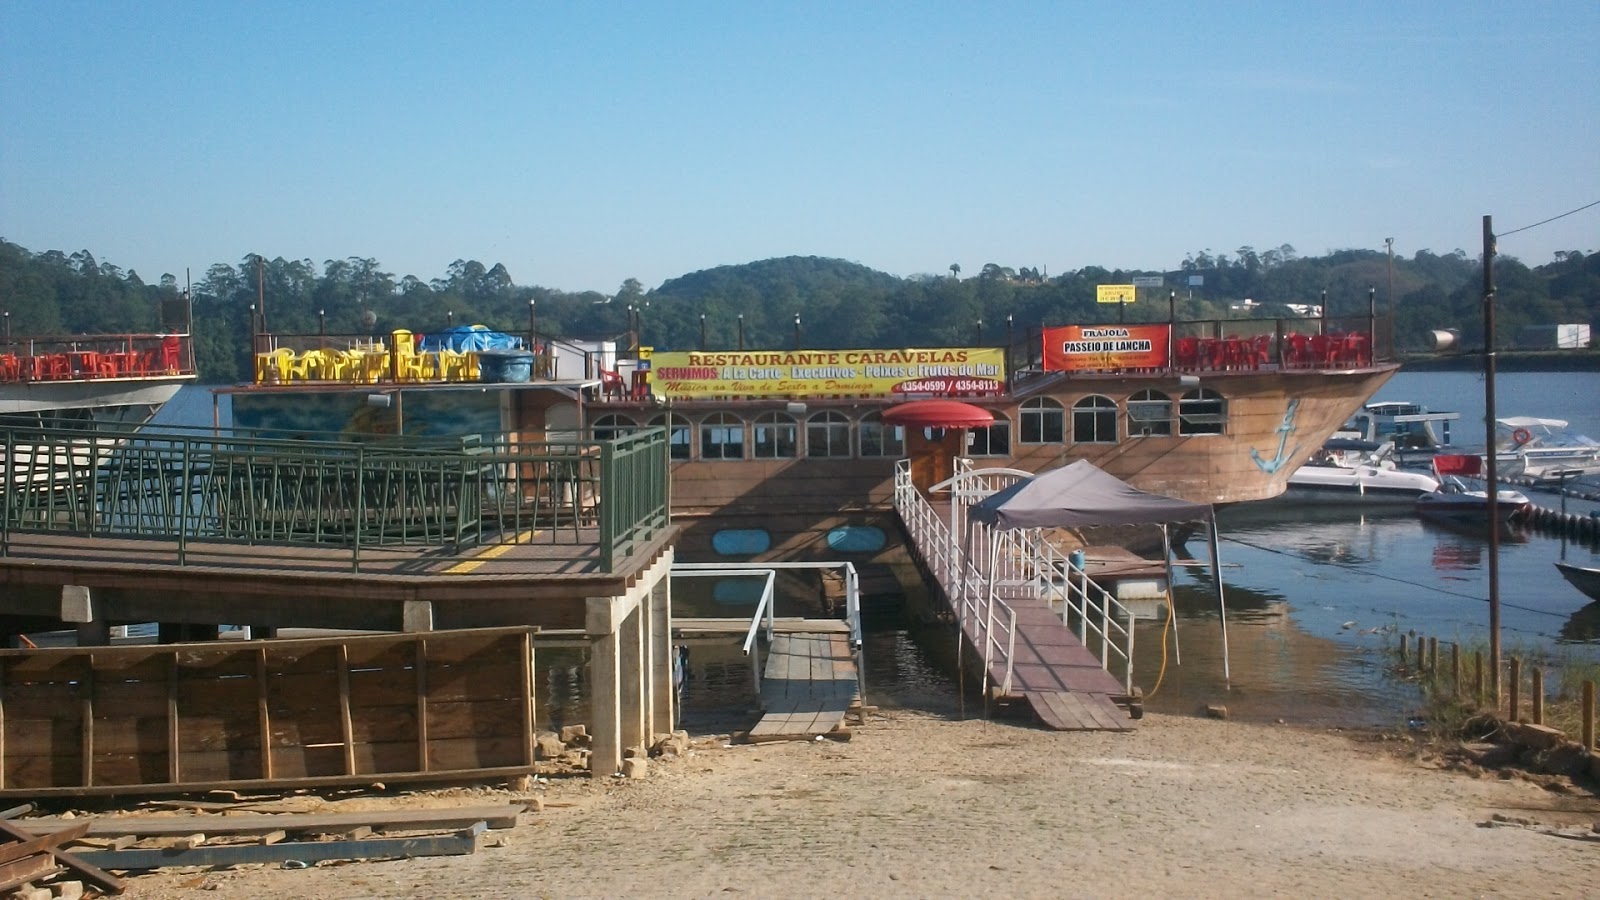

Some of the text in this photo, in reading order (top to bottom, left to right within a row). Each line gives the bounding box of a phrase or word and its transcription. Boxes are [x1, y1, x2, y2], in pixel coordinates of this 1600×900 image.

[1083, 329, 1129, 338] FRAJOLA
[1064, 341, 1150, 352] PASSEIO DE LANCHA
[689, 351, 968, 366] RESTAURANTE CARAVELAS
[722, 367, 731, 380] A
[733, 367, 746, 380] La
[749, 367, 782, 380] Carte
[791, 366, 856, 380] Executivos
[865, 365, 906, 378] Peixes
[908, 367, 915, 378] e
[917, 364, 956, 377] Frutos
[959, 364, 973, 376] do
[976, 363, 999, 376] Mar
[731, 381, 754, 391] Vivo
[760, 382, 772, 391] de
[778, 380, 806, 391] Sexta
[825, 380, 873, 391] Domingo
[902, 380, 999, 392] 4354-0599 / 4354-8113
